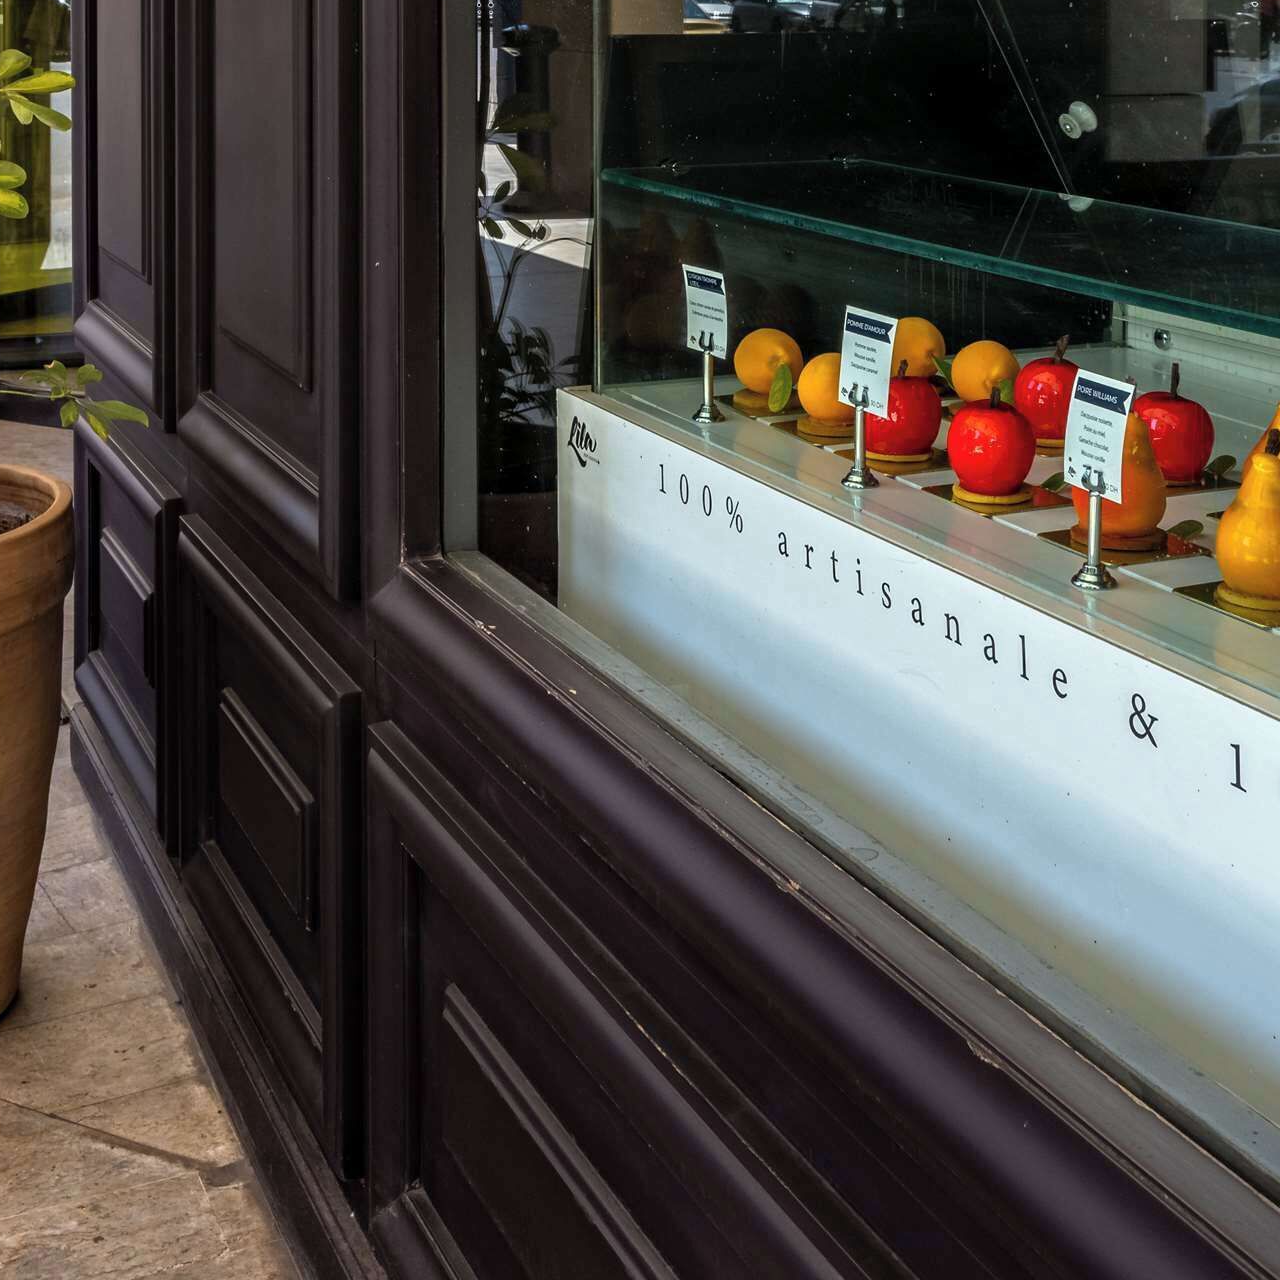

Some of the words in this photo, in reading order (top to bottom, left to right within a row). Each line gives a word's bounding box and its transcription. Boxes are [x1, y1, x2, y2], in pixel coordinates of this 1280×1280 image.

[847, 318, 864, 330] POMME
[864, 324, 886, 335] D'AMOUR
[1077, 384, 1092, 397] POIRE
[1092, 388, 1118, 405] WILLIAMS
[567, 416, 598, 468] Lila
[658, 463, 745, 534] 100%
[778, 531, 1069, 700] artisanale
[1129, 692, 1158, 749] &
